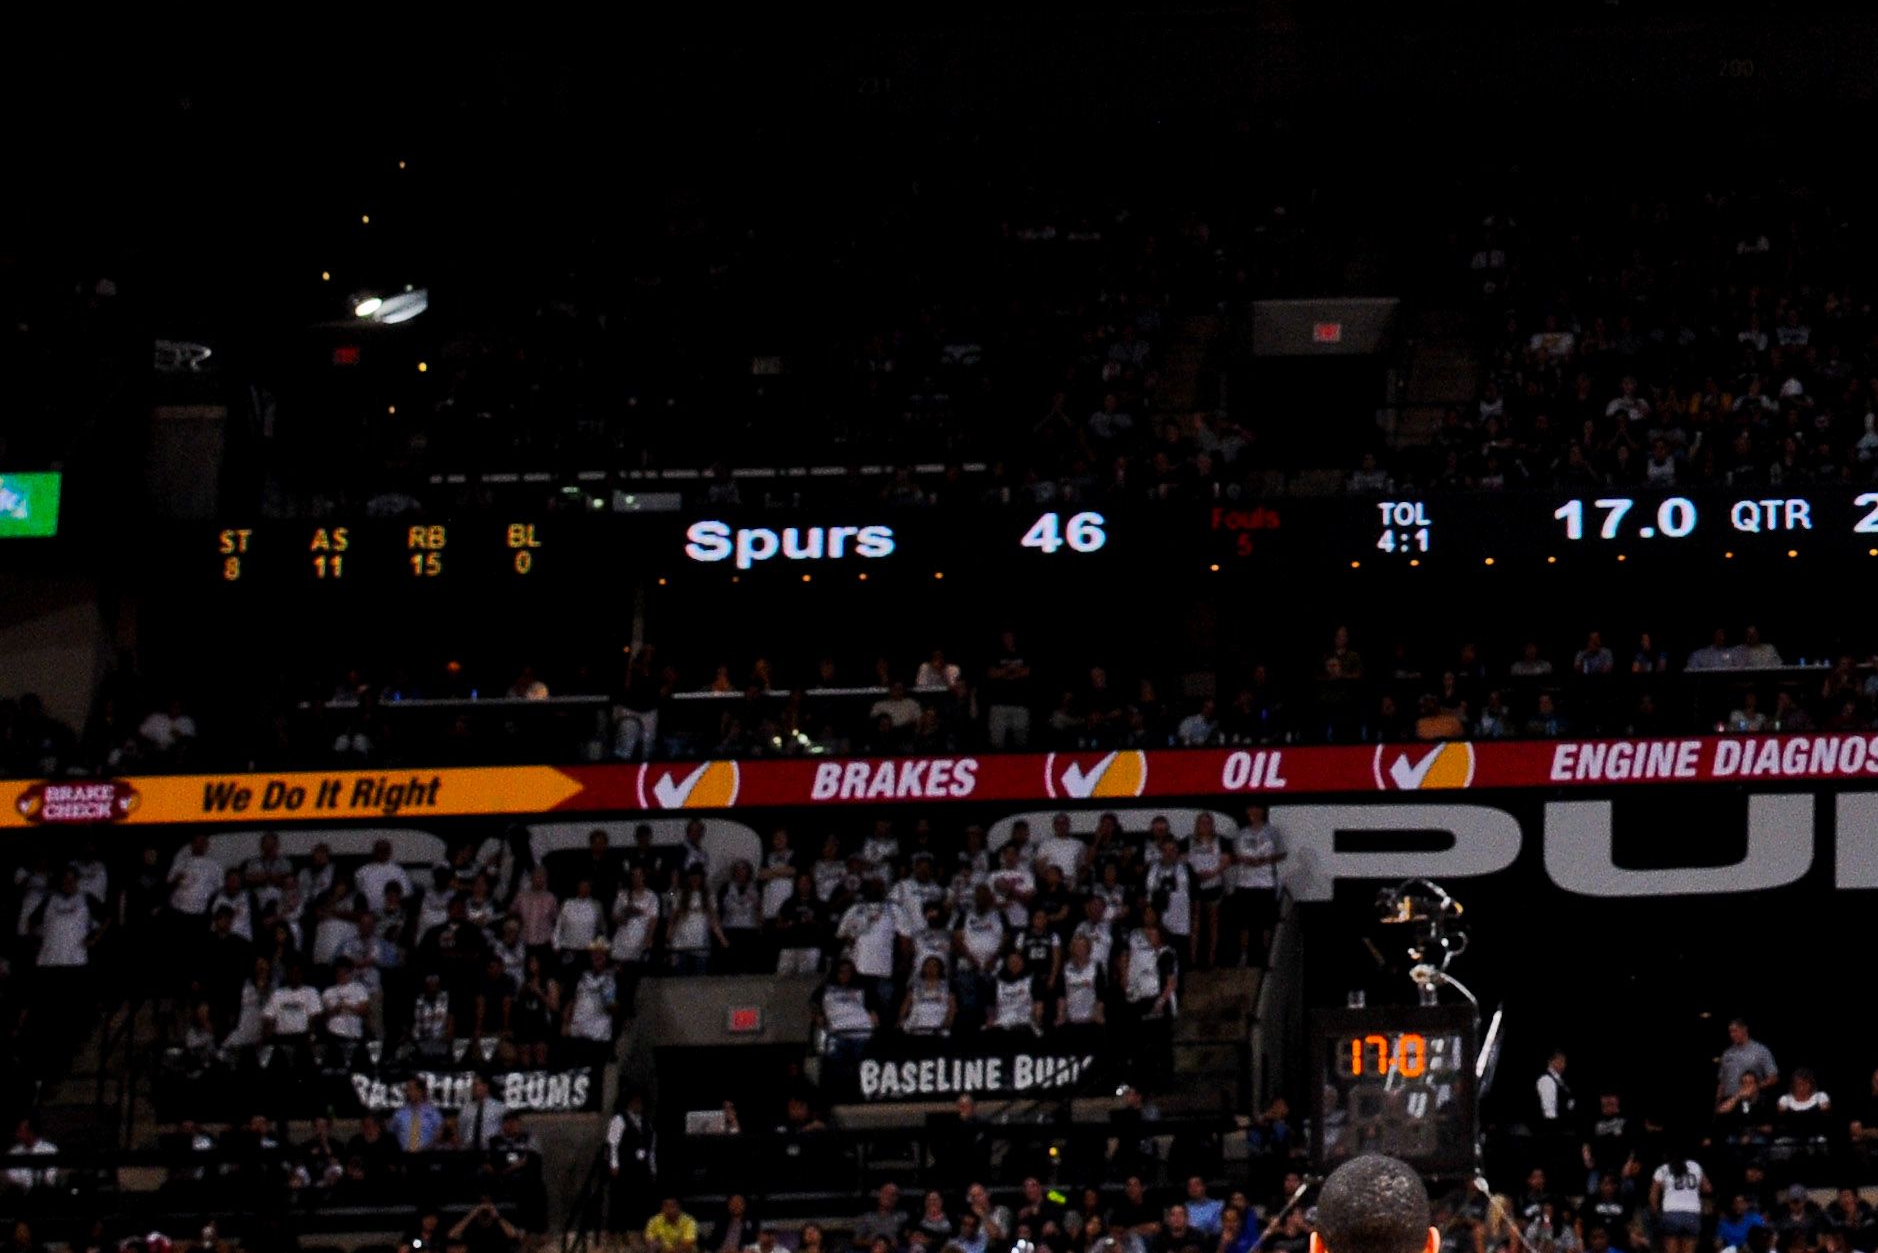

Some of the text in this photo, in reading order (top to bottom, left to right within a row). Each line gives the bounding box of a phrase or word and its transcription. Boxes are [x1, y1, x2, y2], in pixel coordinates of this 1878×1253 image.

[1377, 501, 1432, 527] TOL
[1554, 496, 1698, 540] 17.0
[1730, 498, 1813, 533] QTR
[219, 529, 252, 554] ST
[310, 527, 348, 552] AS
[407, 525, 446, 550] RB
[506, 523, 541, 549] BL
[684, 519, 896, 570] Spurs
[1020, 511, 1107, 554] 46
[1376, 527, 1430, 553] 4:1
[223, 556, 240, 581] 8
[313, 554, 343, 578] 11
[410, 551, 441, 576] 15
[514, 550, 532, 574] 0
[1222, 751, 1287, 789] OIL
[1551, 741, 1700, 781] ENGINE
[811, 758, 979, 800] BRAKES
[203, 777, 441, 813] We Do It Right
[1350, 1031, 1427, 1079] 17.0
[504, 1068, 591, 1109] BUMS
[859, 1055, 1001, 1099] BASELINE
